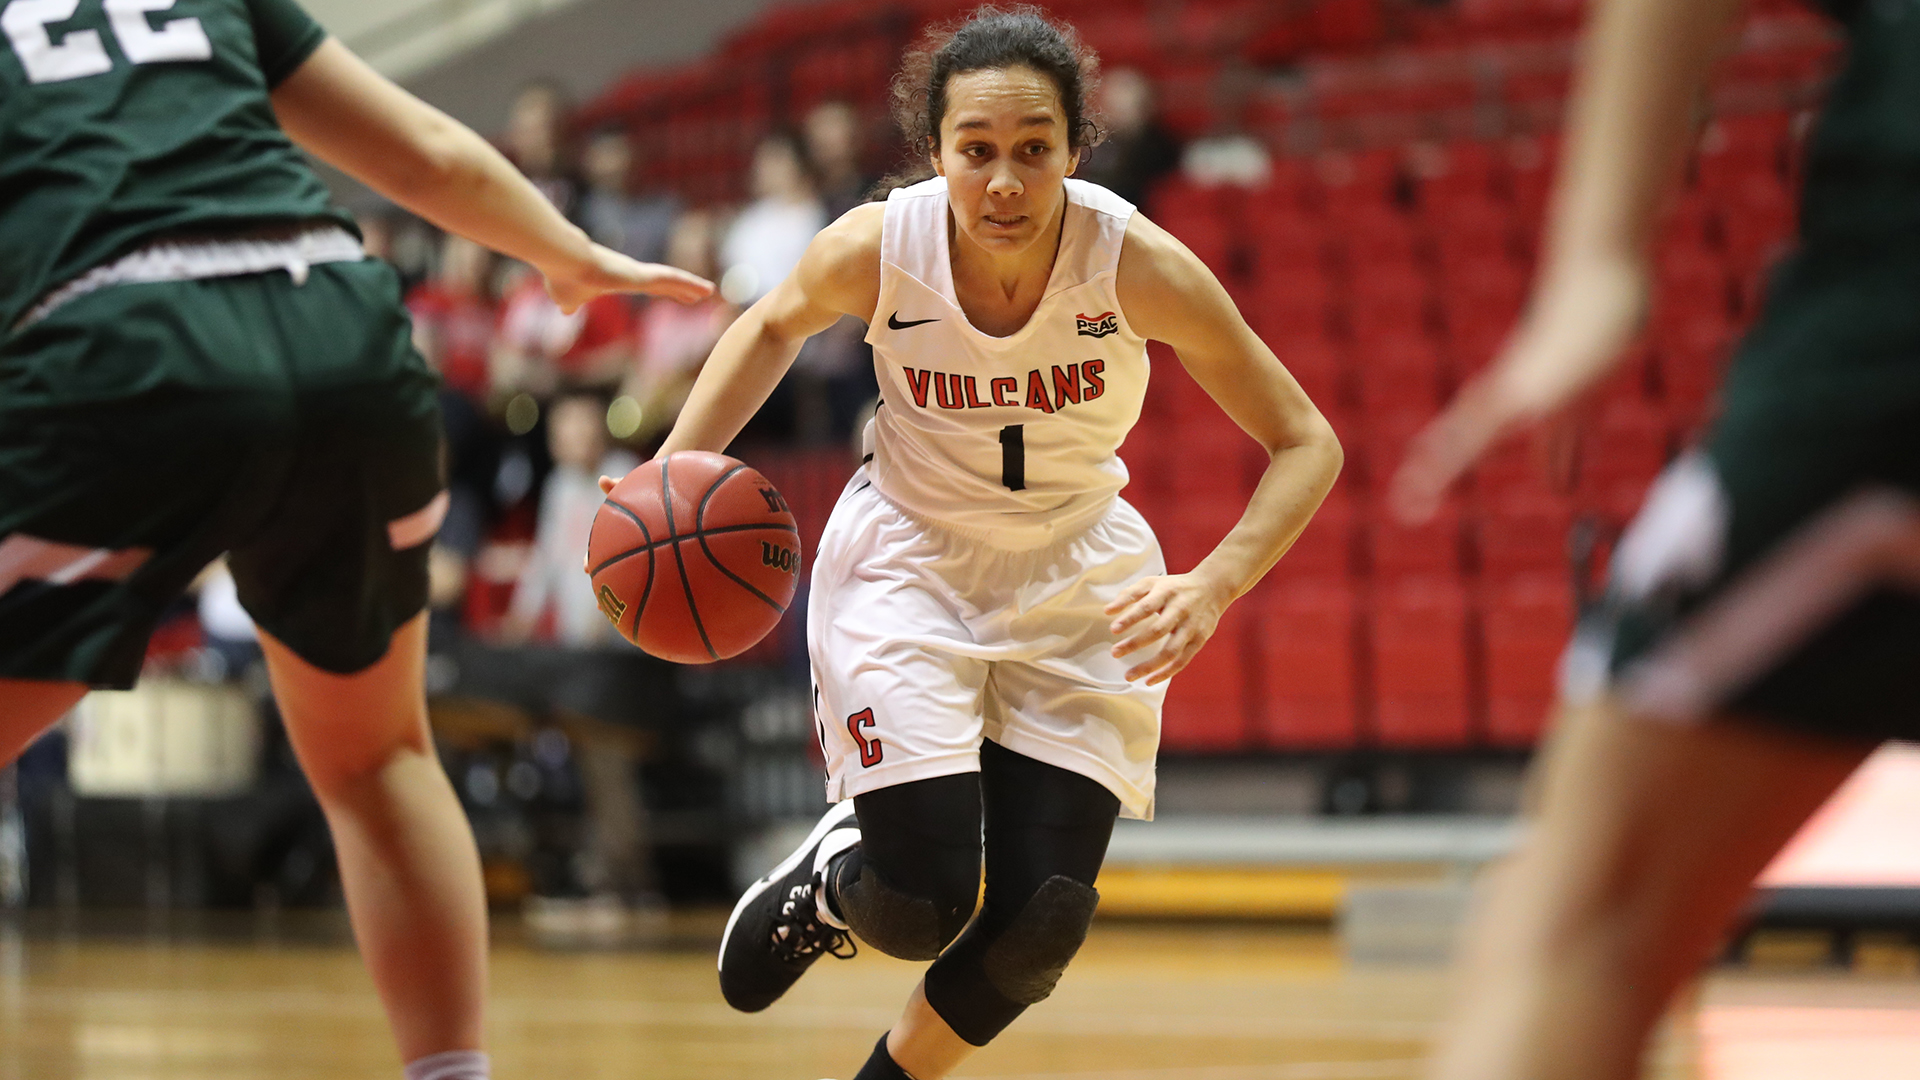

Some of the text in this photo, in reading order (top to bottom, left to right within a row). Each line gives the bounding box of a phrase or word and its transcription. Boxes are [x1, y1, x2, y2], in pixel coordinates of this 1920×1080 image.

[1076, 315, 1118, 333] PSAC
[902, 358, 1105, 414] VULCANS
[998, 423, 1027, 492] 1
[846, 706, 884, 769] C
